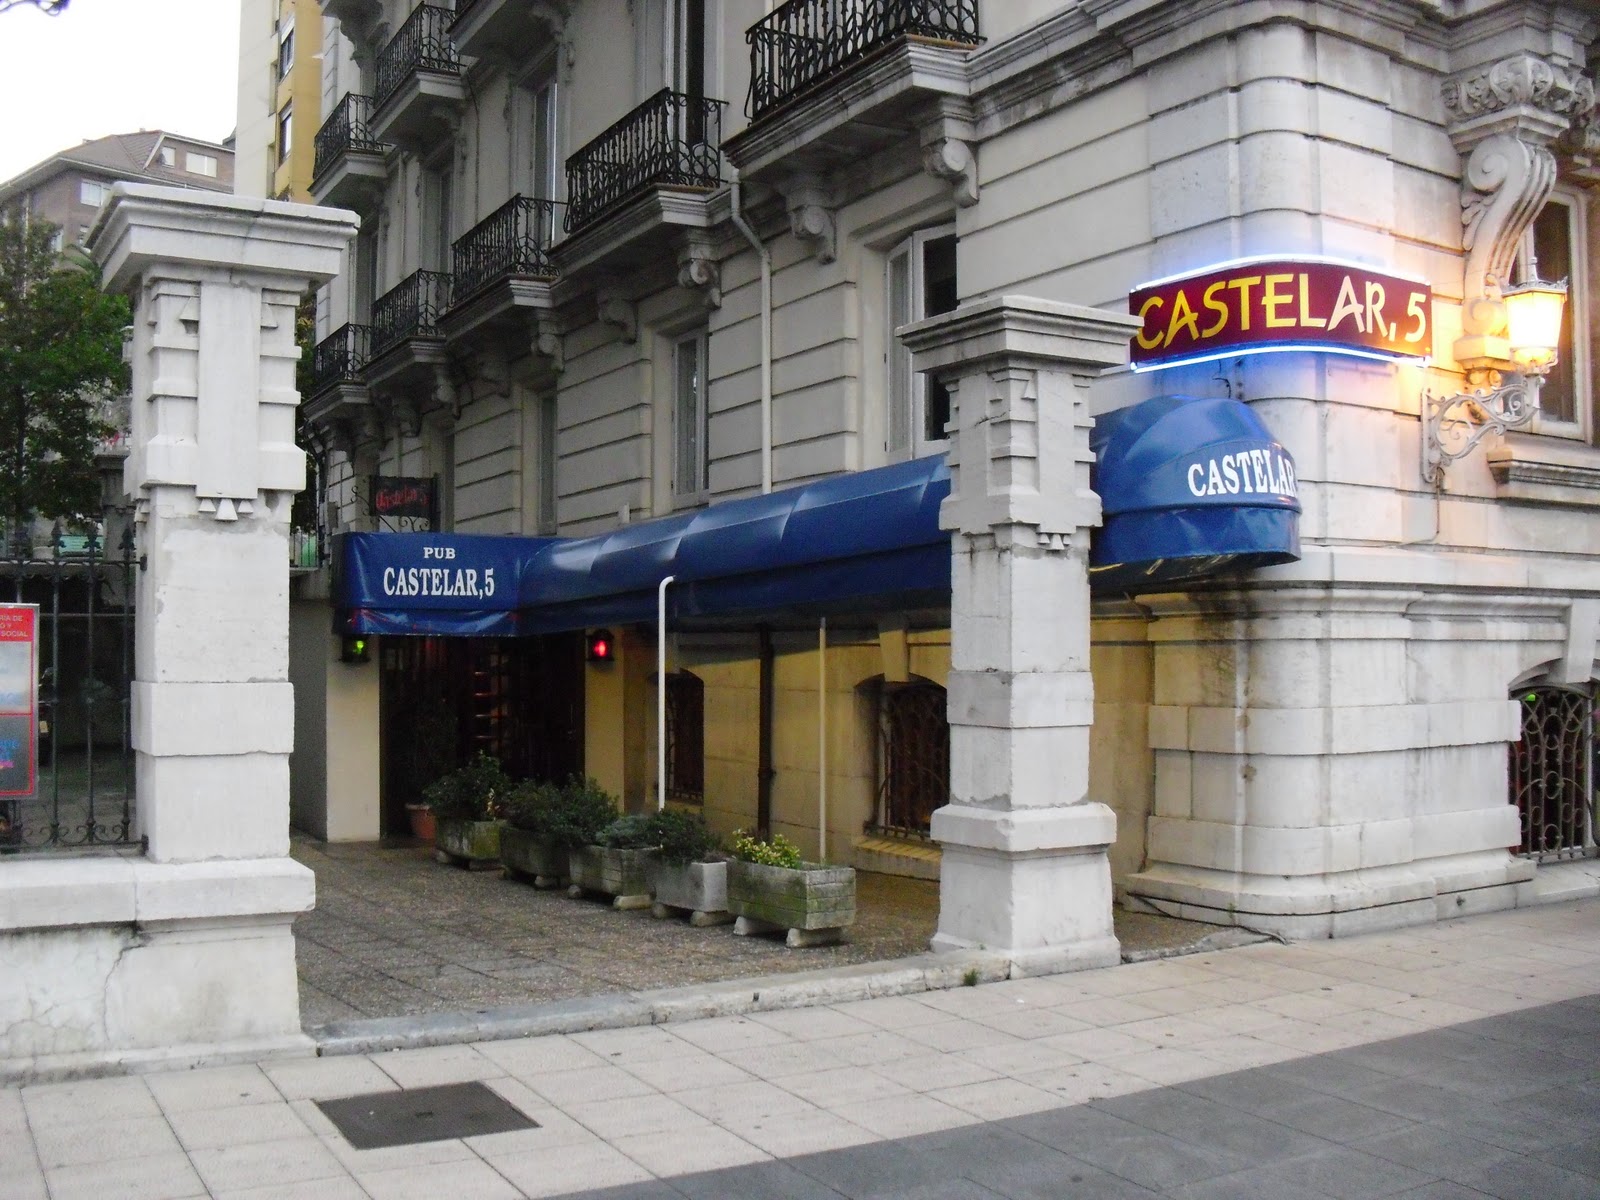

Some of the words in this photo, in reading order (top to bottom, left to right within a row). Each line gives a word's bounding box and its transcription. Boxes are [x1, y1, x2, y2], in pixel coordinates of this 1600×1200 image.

[1135, 273, 1397, 350] CASTELAR,
[1404, 292, 1427, 344] 5
[1187, 449, 1298, 498] CASTELAR
[423, 547, 456, 560] PUB
[383, 567, 495, 600] CASTELAR,5
